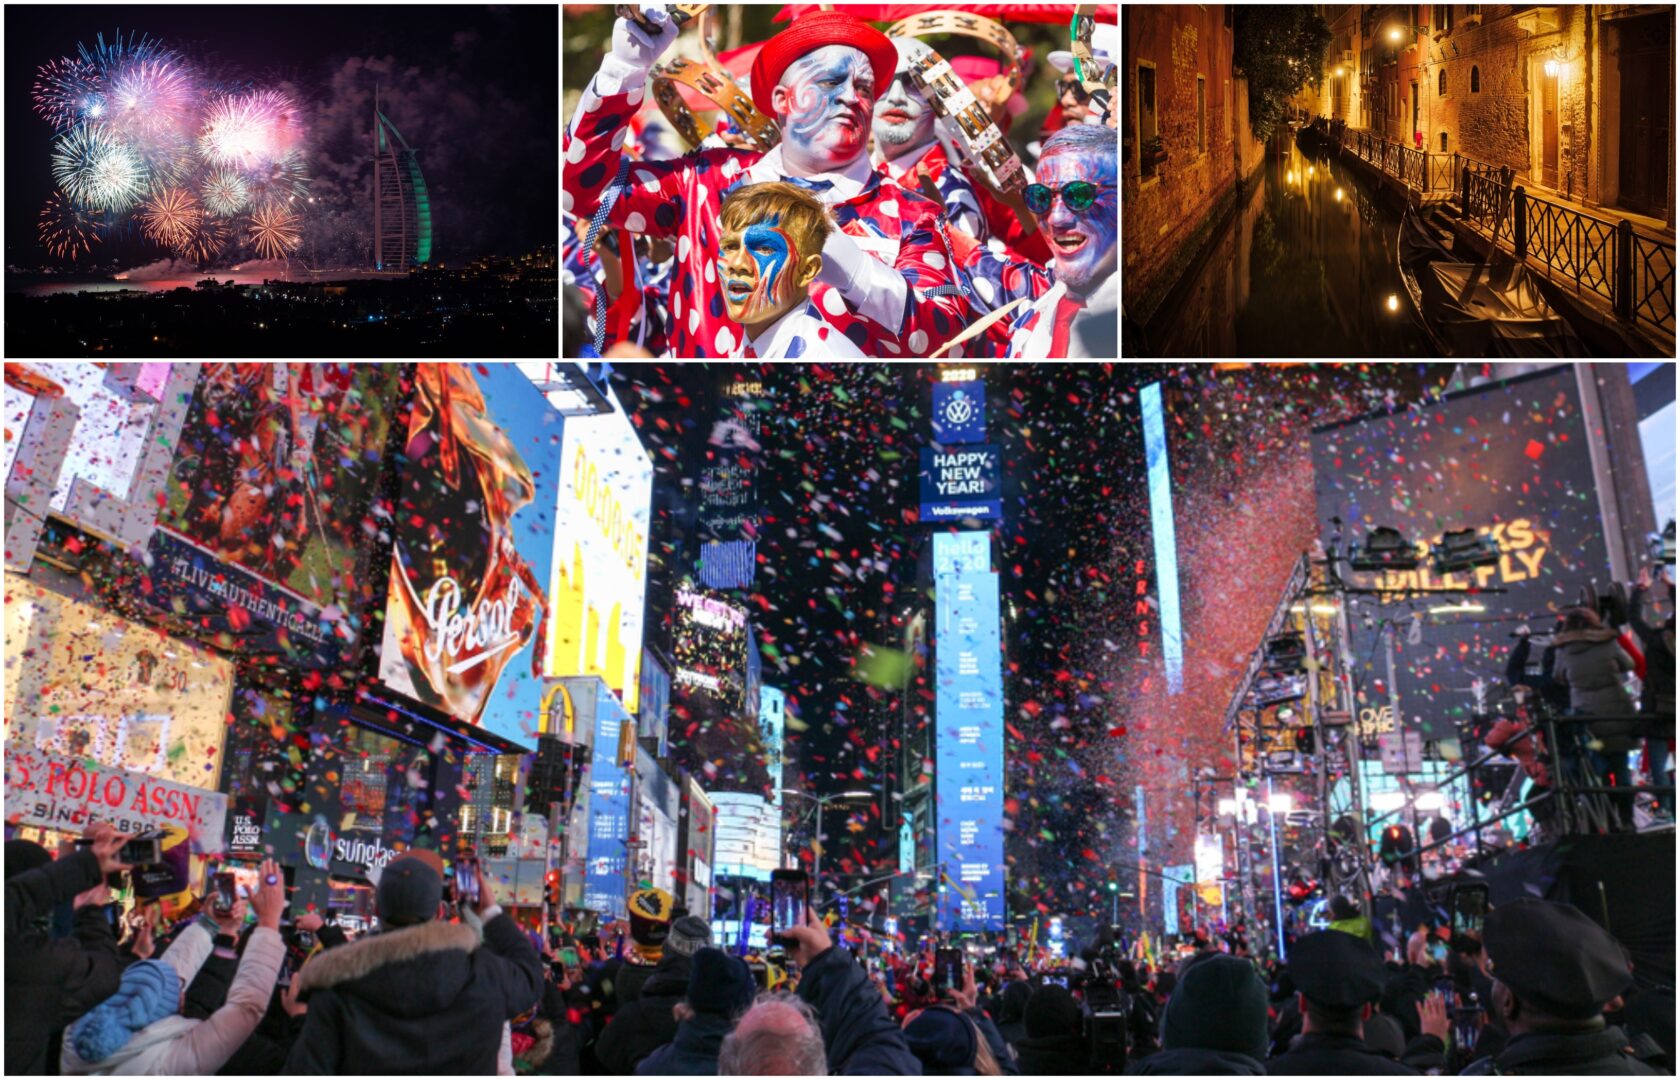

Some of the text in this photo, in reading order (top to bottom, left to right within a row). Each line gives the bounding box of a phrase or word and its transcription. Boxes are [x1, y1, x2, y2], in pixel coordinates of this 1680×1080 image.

[934, 452, 987, 468] HAPPY
[941, 467, 981, 481] NEW
[936, 480, 985, 495] YEAR!
[931, 506, 989, 516] Volkswagen
[1135, 559, 1150, 657] ERNST
[424, 577, 520, 673] Persol
[44, 761, 126, 808] POLO
[130, 782, 203, 825] ASSN.
[233, 825, 260, 834] POLO
